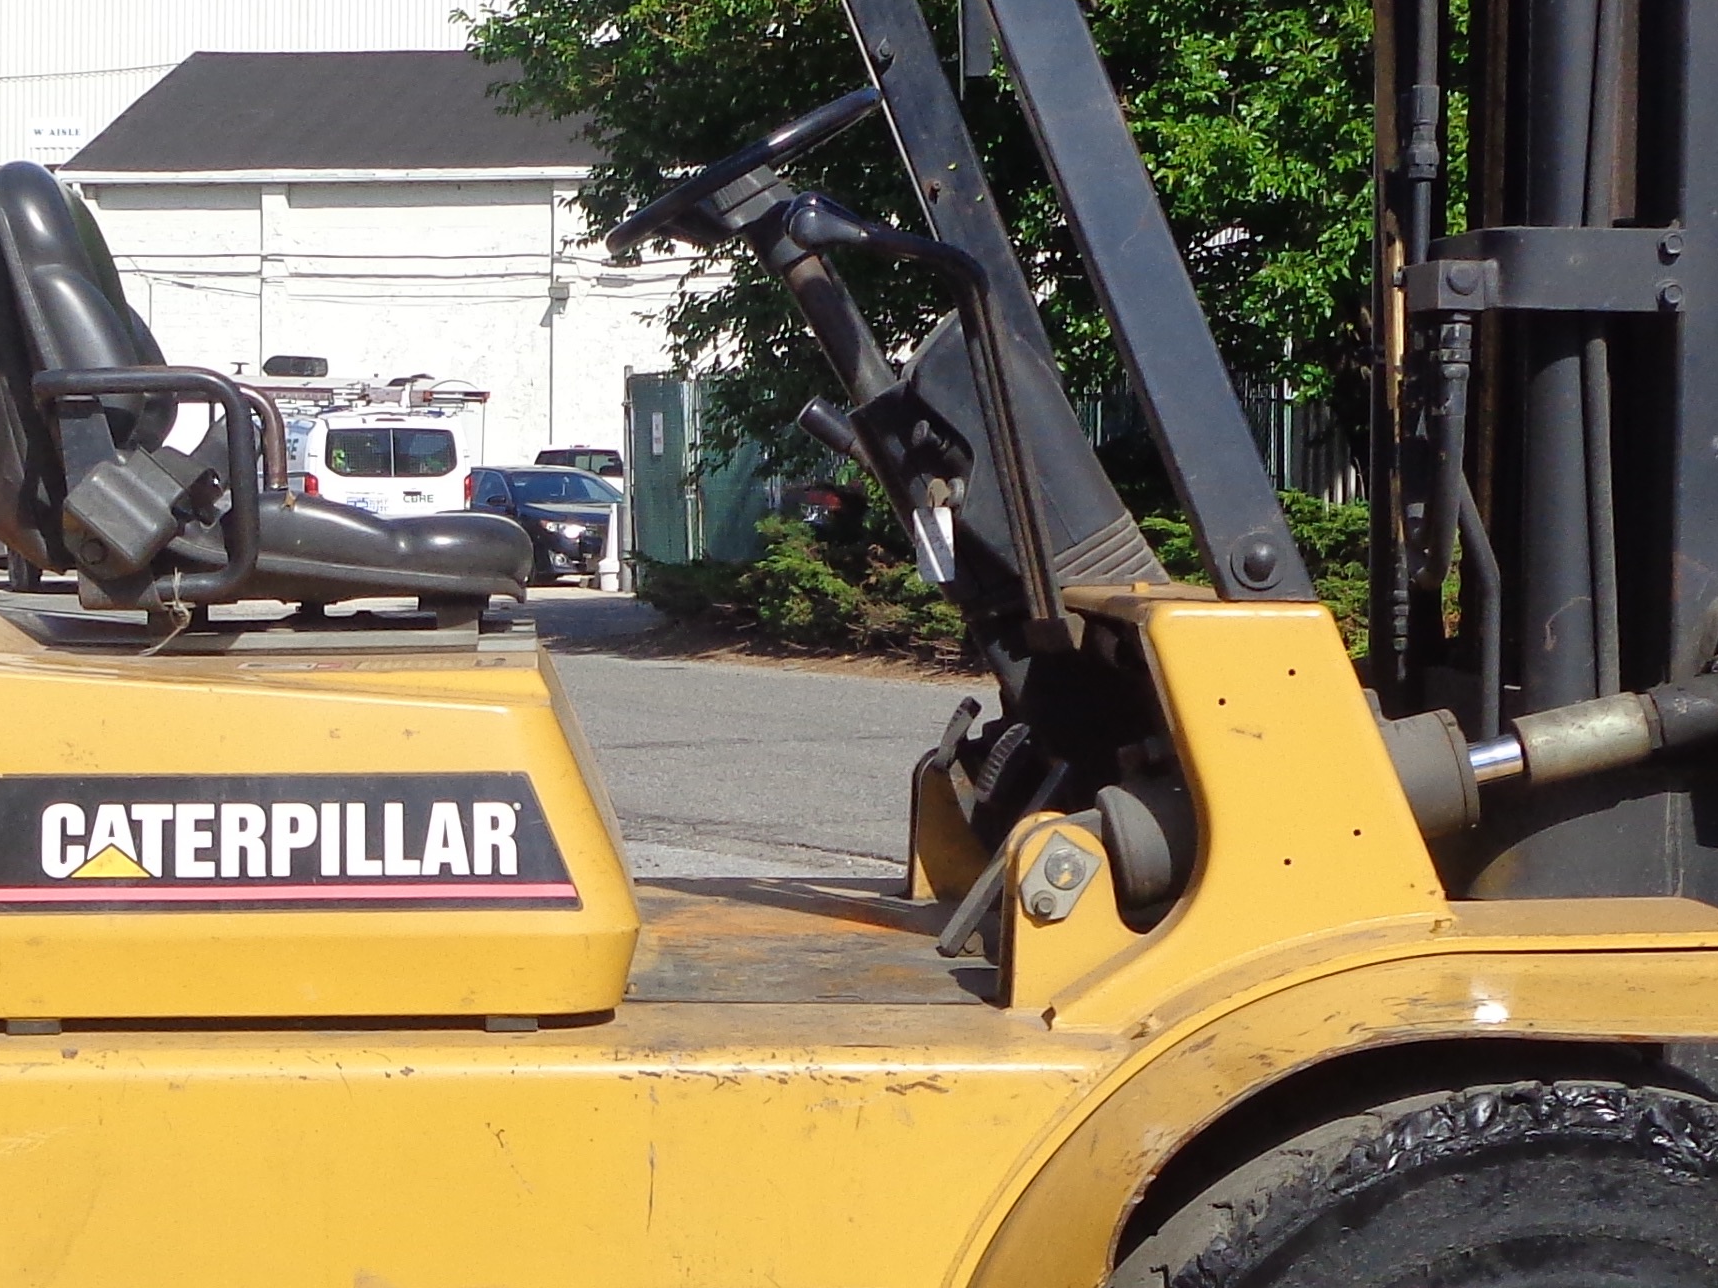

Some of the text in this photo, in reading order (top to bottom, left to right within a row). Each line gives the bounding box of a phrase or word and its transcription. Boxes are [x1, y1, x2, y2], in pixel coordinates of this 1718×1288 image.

[33, 128, 81, 136] W AISLE
[40, 801, 519, 879] CATERPILLAR
